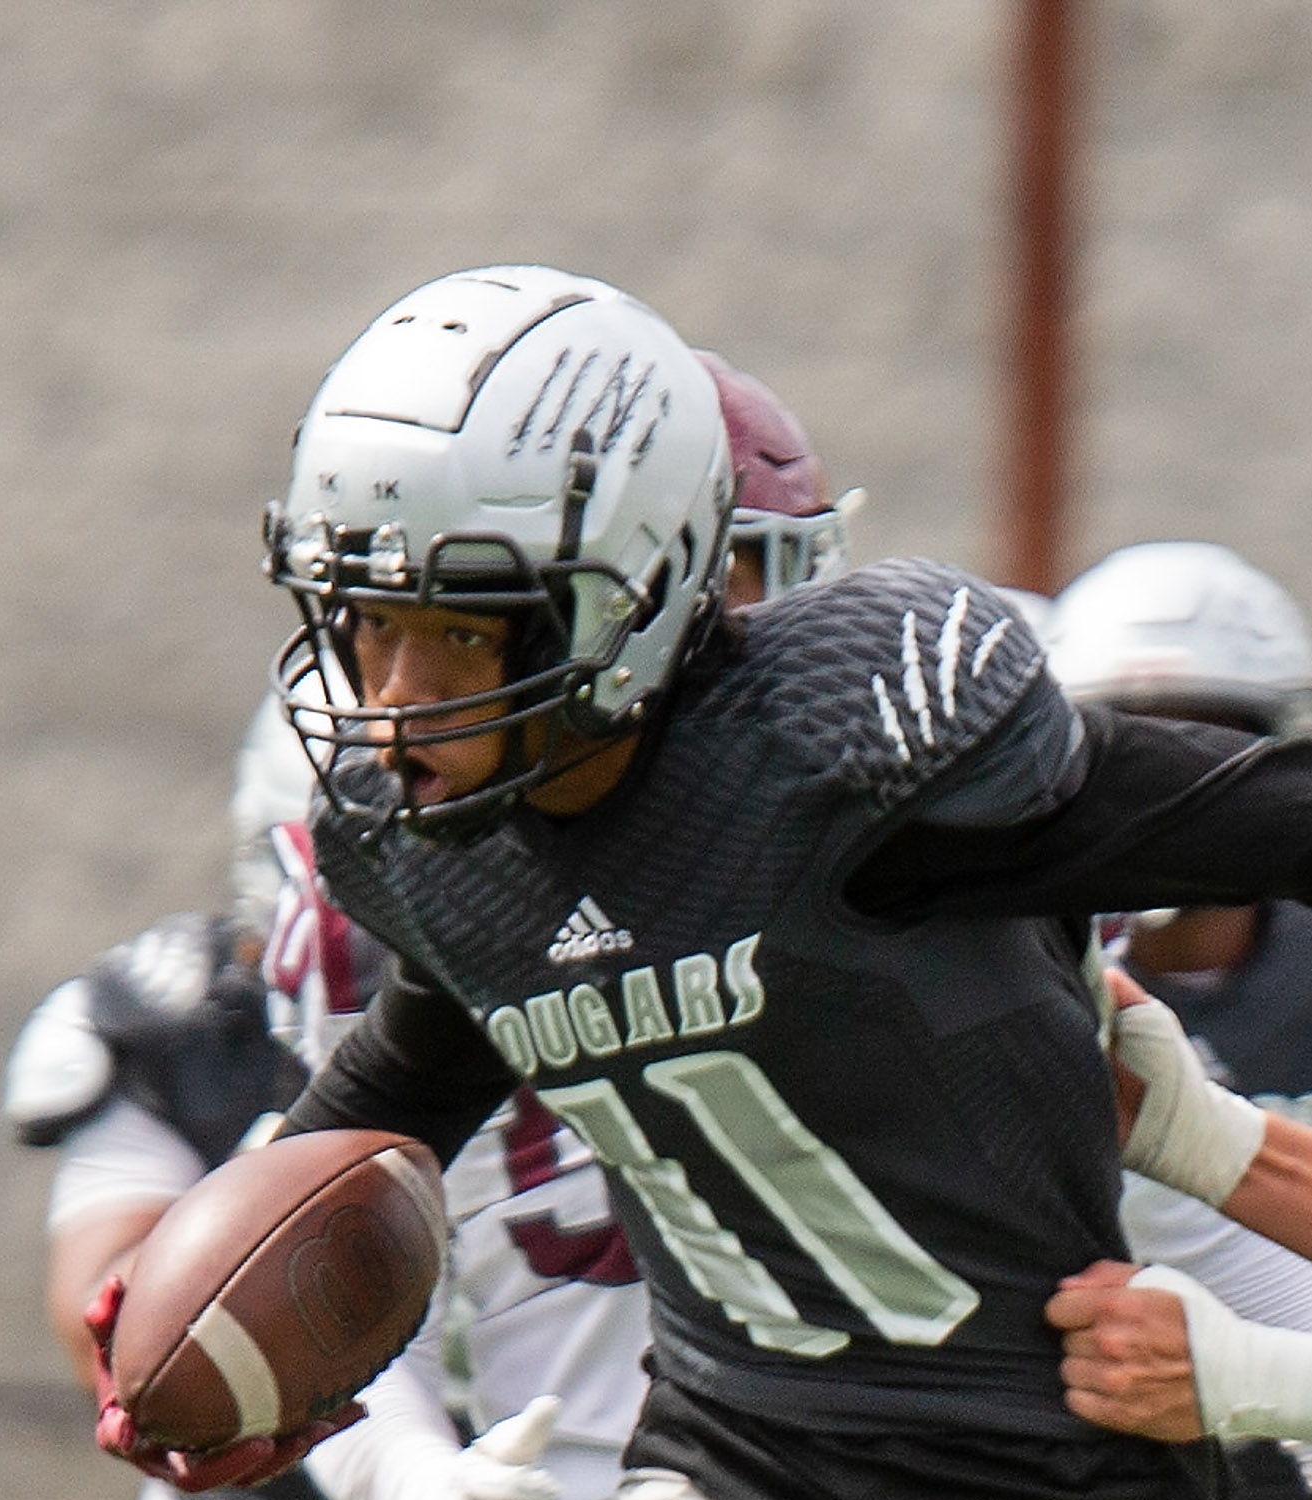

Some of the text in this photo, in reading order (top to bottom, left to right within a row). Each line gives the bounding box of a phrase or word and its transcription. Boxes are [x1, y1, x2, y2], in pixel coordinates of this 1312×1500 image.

[373, 479, 400, 500] 1K
[471, 932, 765, 1076] OUGARS
[537, 1050, 981, 1358] 11
